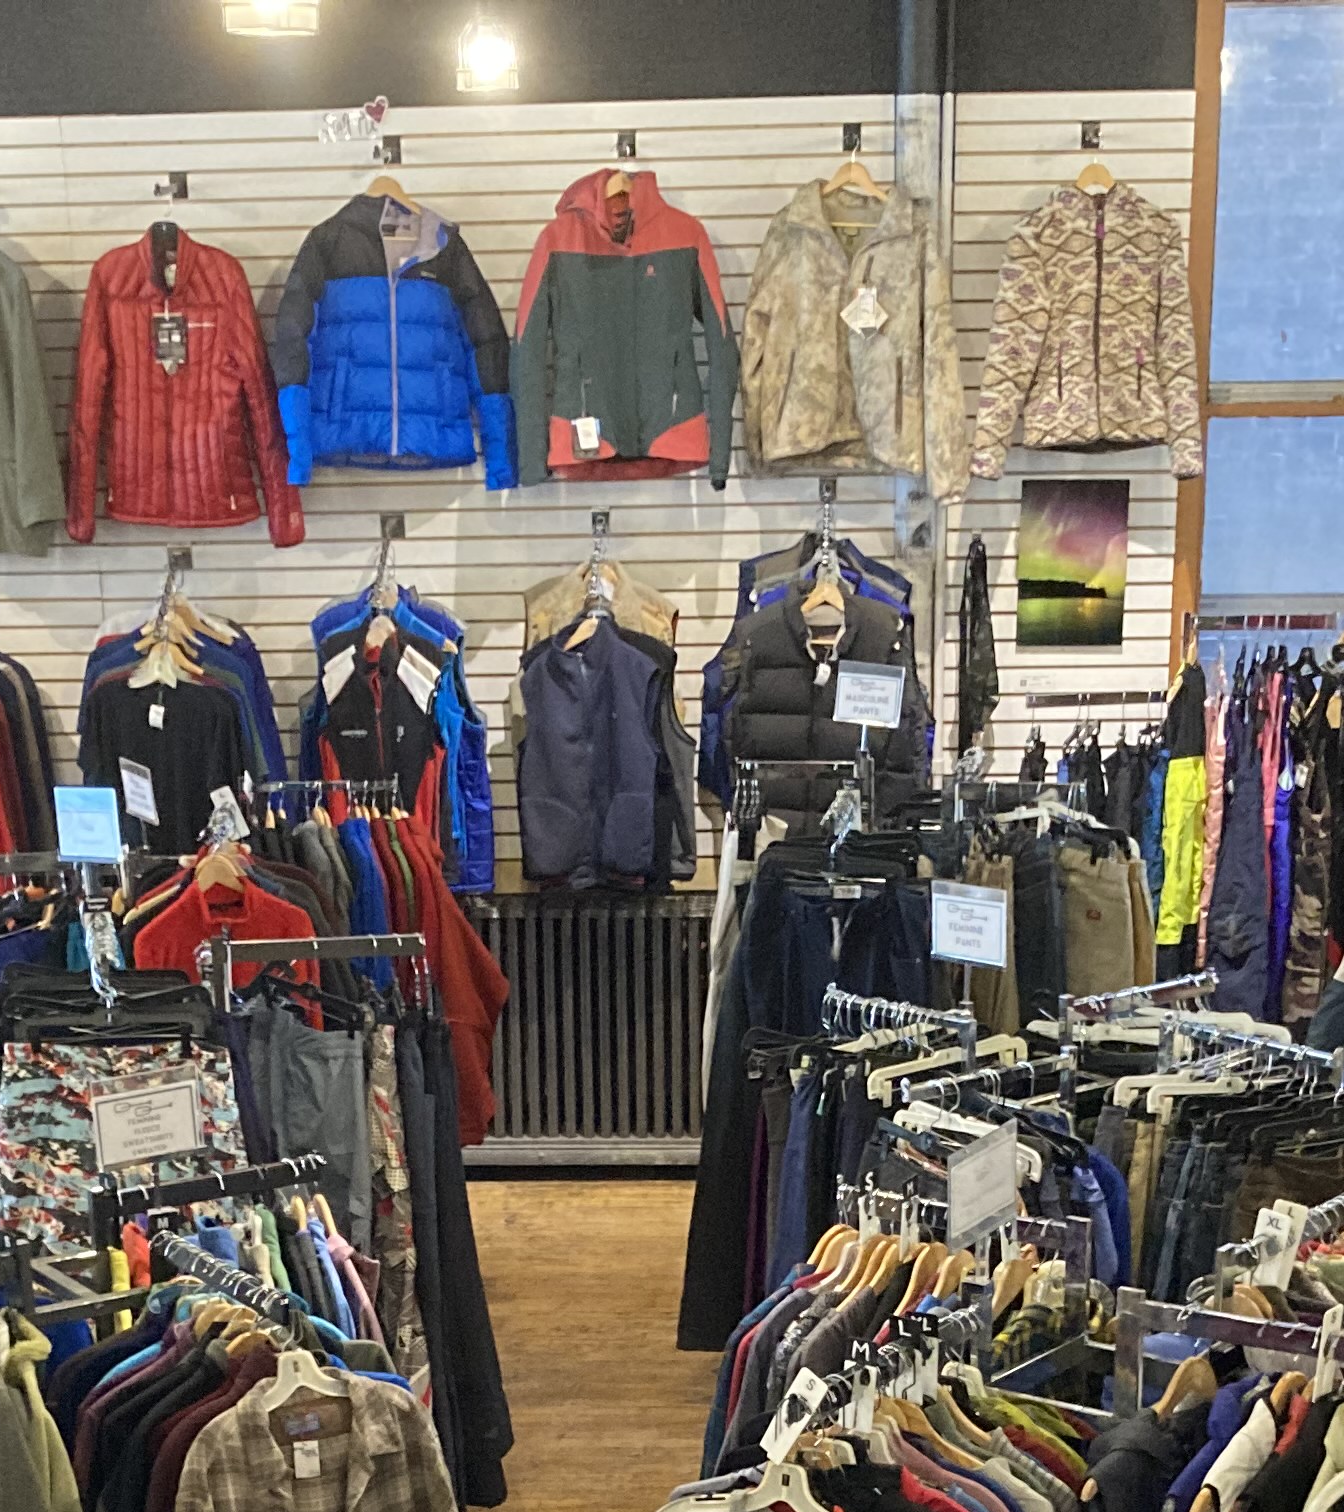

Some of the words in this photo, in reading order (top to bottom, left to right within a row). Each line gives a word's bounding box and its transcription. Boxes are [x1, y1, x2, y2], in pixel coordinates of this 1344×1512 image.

[853, 706, 879, 716] PANTS
[157, 1217, 169, 1230] M
[1266, 1216, 1282, 1230] XL
[851, 1340, 870, 1362] M
